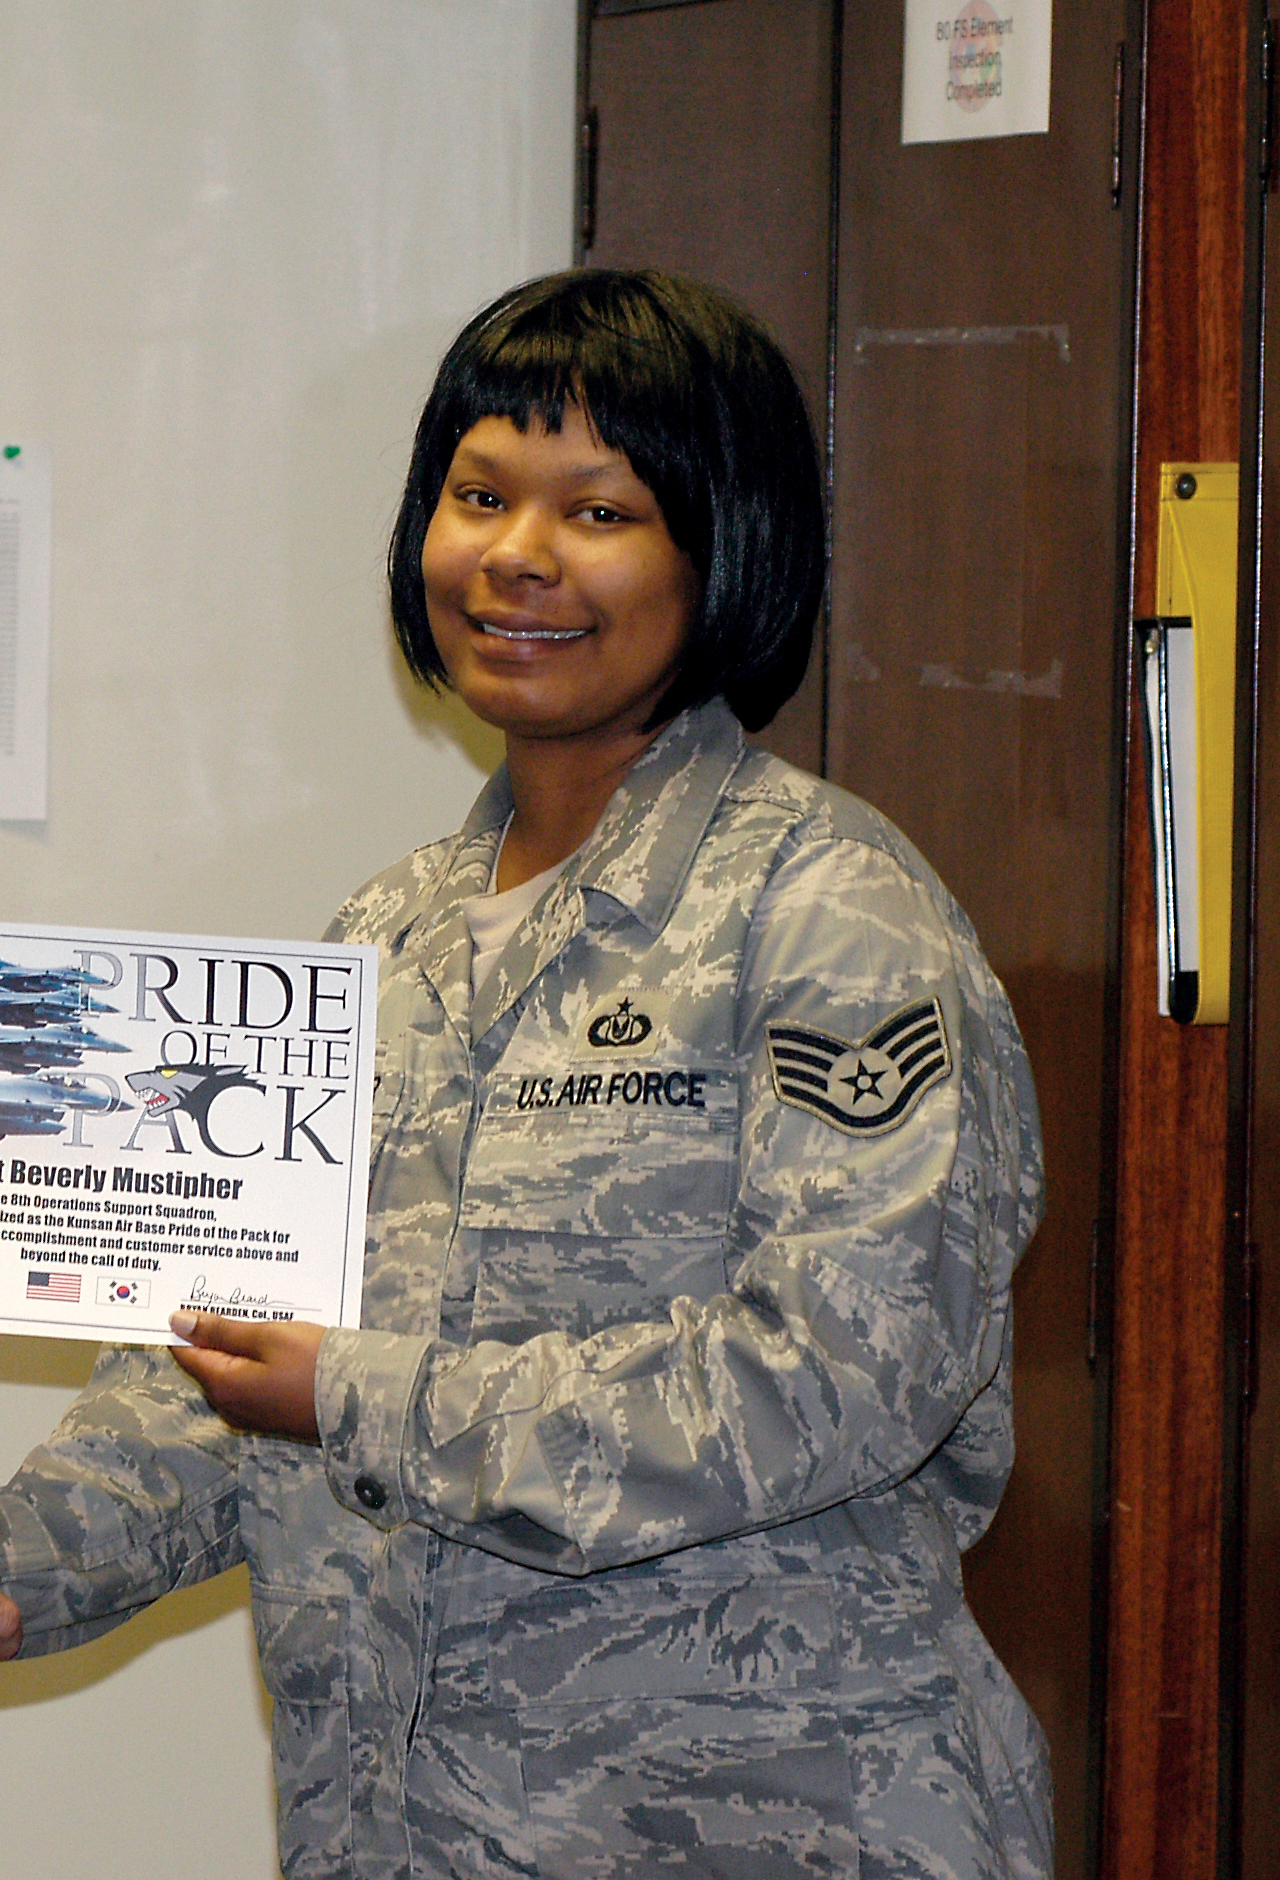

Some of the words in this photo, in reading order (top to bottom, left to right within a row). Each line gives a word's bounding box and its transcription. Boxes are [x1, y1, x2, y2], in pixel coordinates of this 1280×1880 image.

[971, 16, 1013, 37] Element
[946, 80, 1001, 102] Completed
[73, 950, 352, 1034] PRIDE
[160, 1029, 231, 1066] OF
[244, 1034, 350, 1080] THE
[516, 1077, 553, 1109] U.S.
[555, 1074, 603, 1107] AIR
[606, 1071, 707, 1108] FORCE
[63, 1072, 346, 1165] PACK
[10, 1159, 107, 1193] Beverly
[111, 1166, 243, 1200] Mustipher
[10, 1193, 31, 1207] 8th
[33, 1195, 102, 1213] Operations
[103, 1200, 153, 1217] Support
[154, 1204, 217, 1222] Squadron,
[26, 1214, 42, 1226] as
[44, 1214, 65, 1227] the
[66, 1215, 113, 1231] Kunsan
[114, 1219, 132, 1233] Air
[135, 1221, 166, 1235] Base
[168, 1223, 200, 1238] Pride
[203, 1225, 216, 1239] of
[218, 1226, 238, 1240] the
[240, 1228, 270, 1243] Pack
[272, 1230, 290, 1244] for
[20, 1247, 66, 1263] beyond
[68, 1250, 89, 1265] the
[91, 1252, 114, 1267] call
[117, 1254, 130, 1268] of
[131, 1256, 162, 1272] duty.
[100, 1236, 123, 1250] and
[125, 1240, 184, 1255] customer
[187, 1243, 233, 1258] service
[235, 1247, 273, 1261] above
[275, 1249, 299, 1263] and
